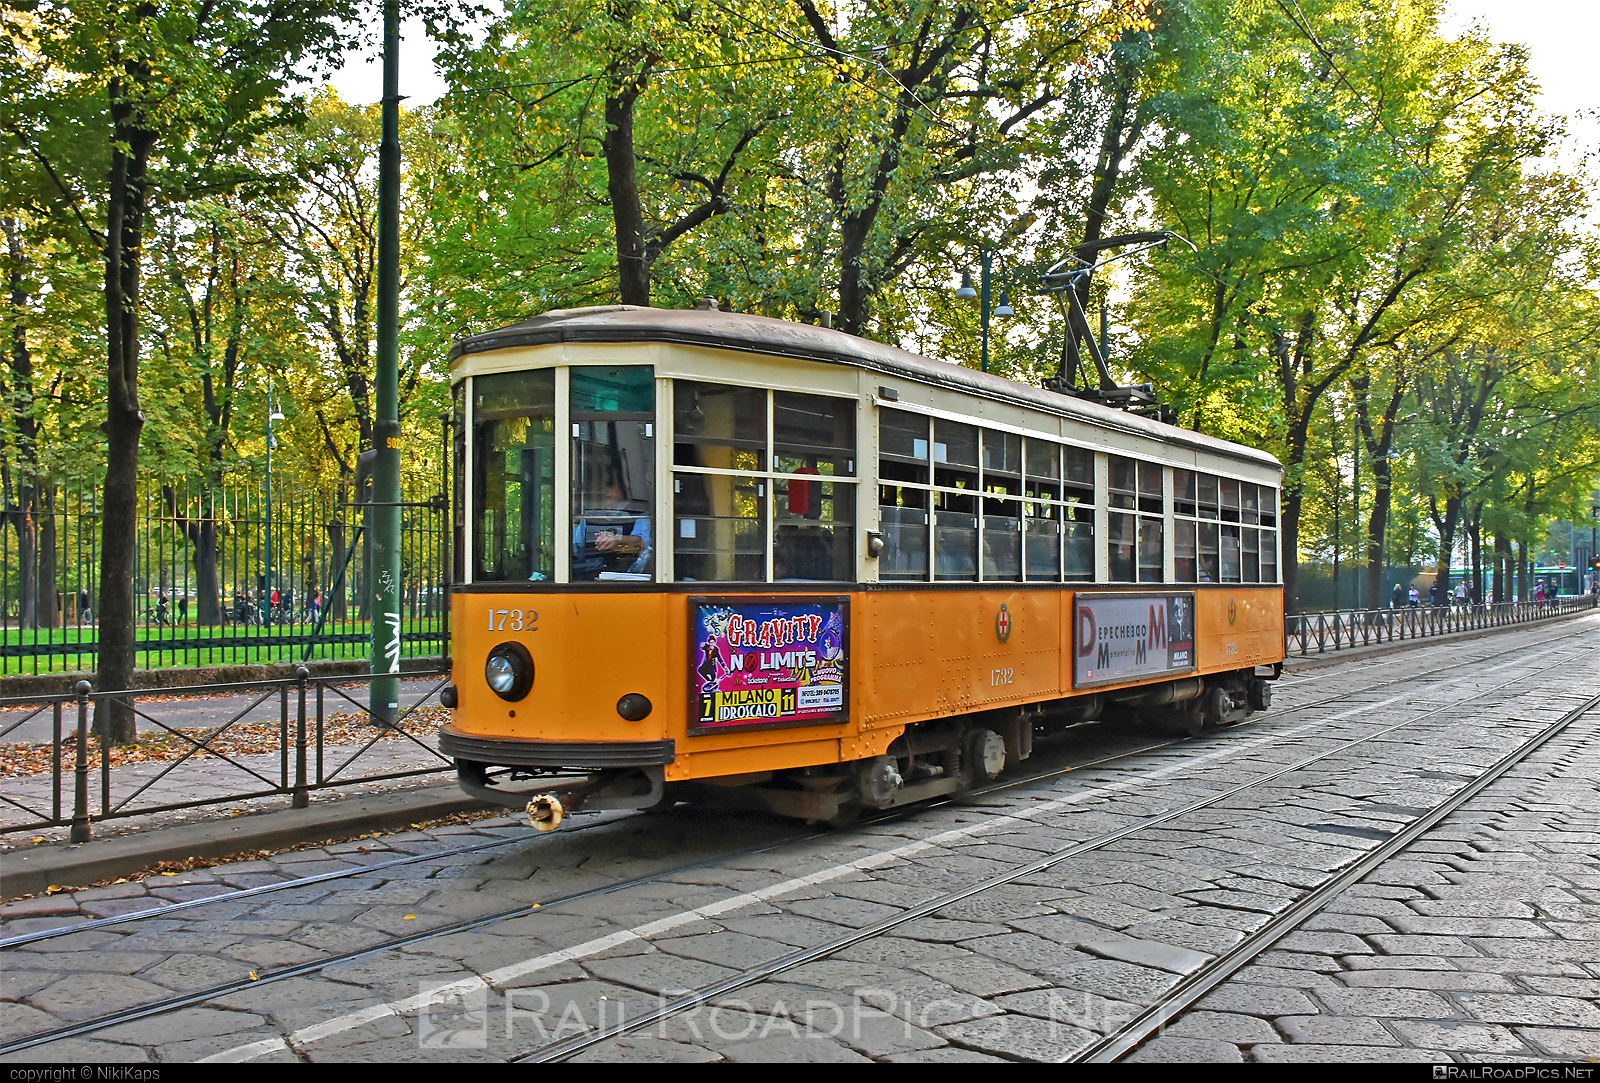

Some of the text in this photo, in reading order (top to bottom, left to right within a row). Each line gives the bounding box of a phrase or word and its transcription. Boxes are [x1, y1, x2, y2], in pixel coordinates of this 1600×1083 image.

[488, 609, 538, 631] 1732
[727, 614, 822, 648] GRAVITY
[760, 651, 816, 670] LIMITS
[810, 673, 842, 683] PROGRAMMA
[991, 667, 1014, 687] 1732
[722, 686, 775, 706] MILANO
[782, 694, 795, 711] 11
[703, 699, 712, 717] 7
[720, 703, 777, 720] IDROSCALO
